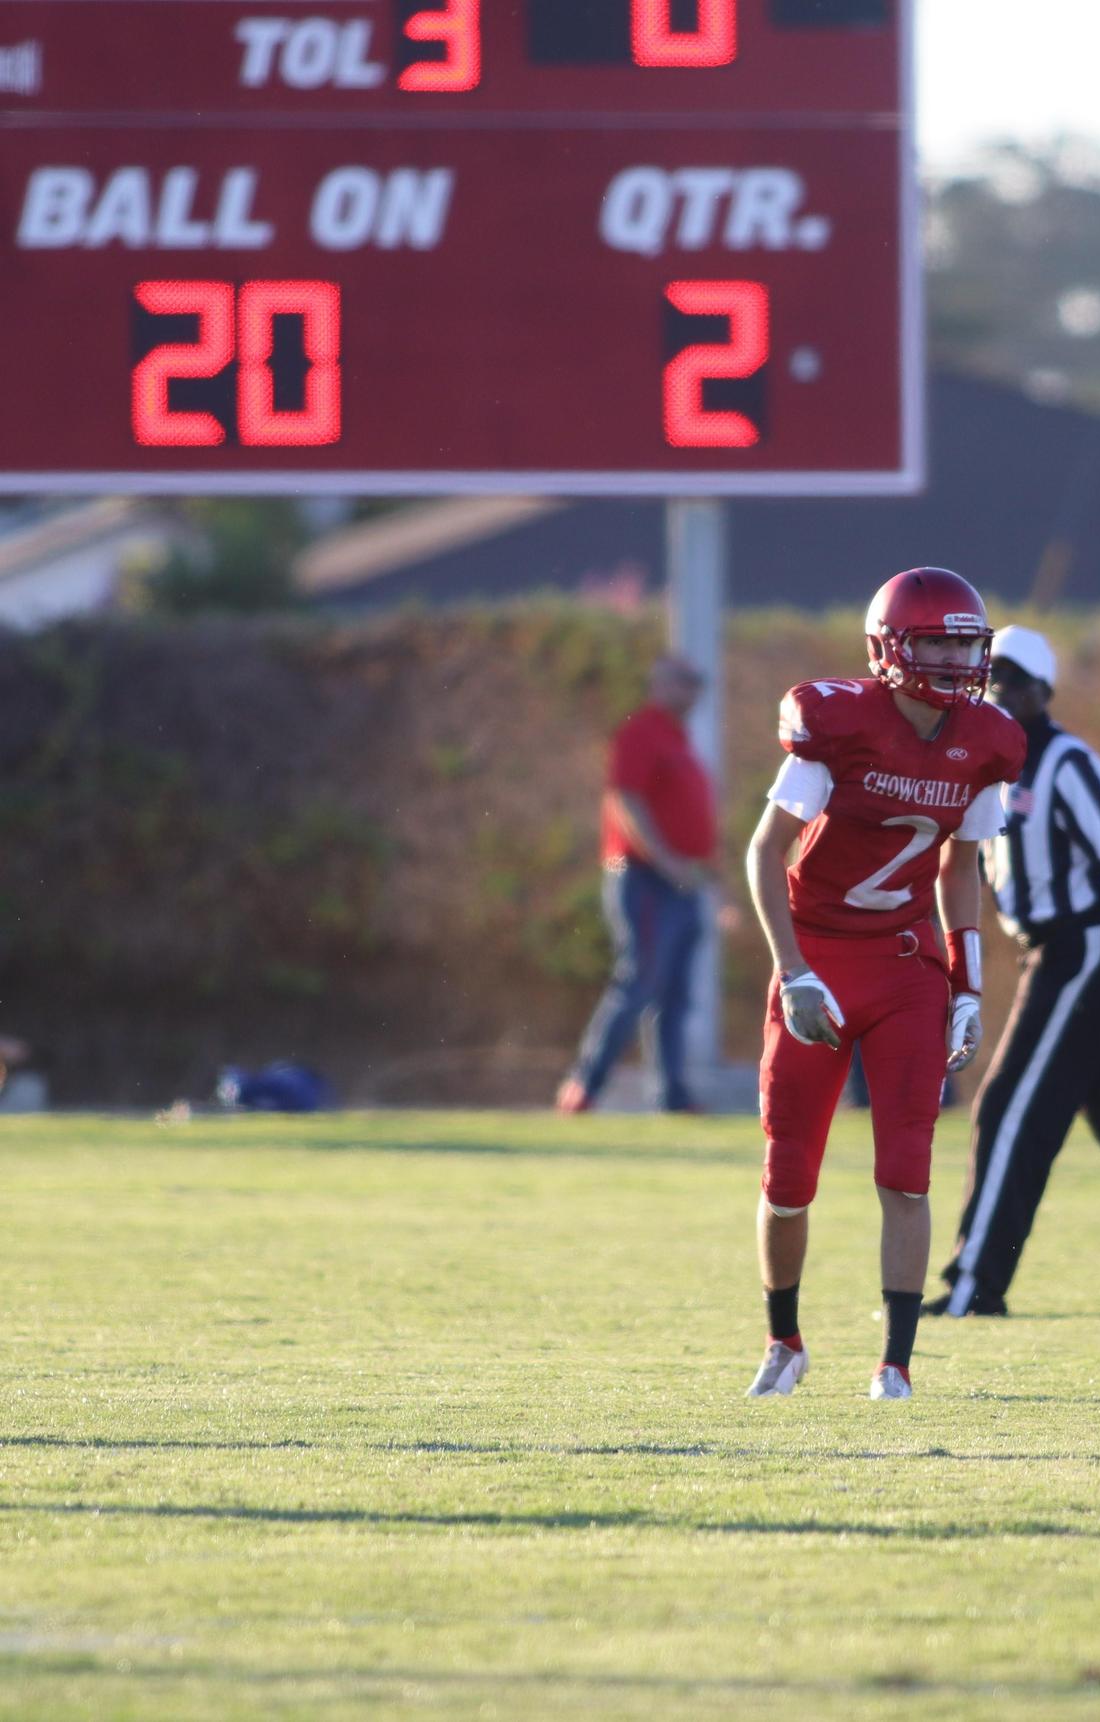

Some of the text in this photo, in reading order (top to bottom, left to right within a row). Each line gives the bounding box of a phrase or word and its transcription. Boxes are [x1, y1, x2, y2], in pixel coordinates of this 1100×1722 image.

[235, 16, 386, 89] TOL
[16, 165, 453, 251] BALL ON
[599, 165, 831, 256] QTR.
[131, 279, 342, 447] 20
[663, 279, 770, 448] 2
[863, 771, 972, 807] CHOWCHILLA
[843, 815, 940, 911] 2
